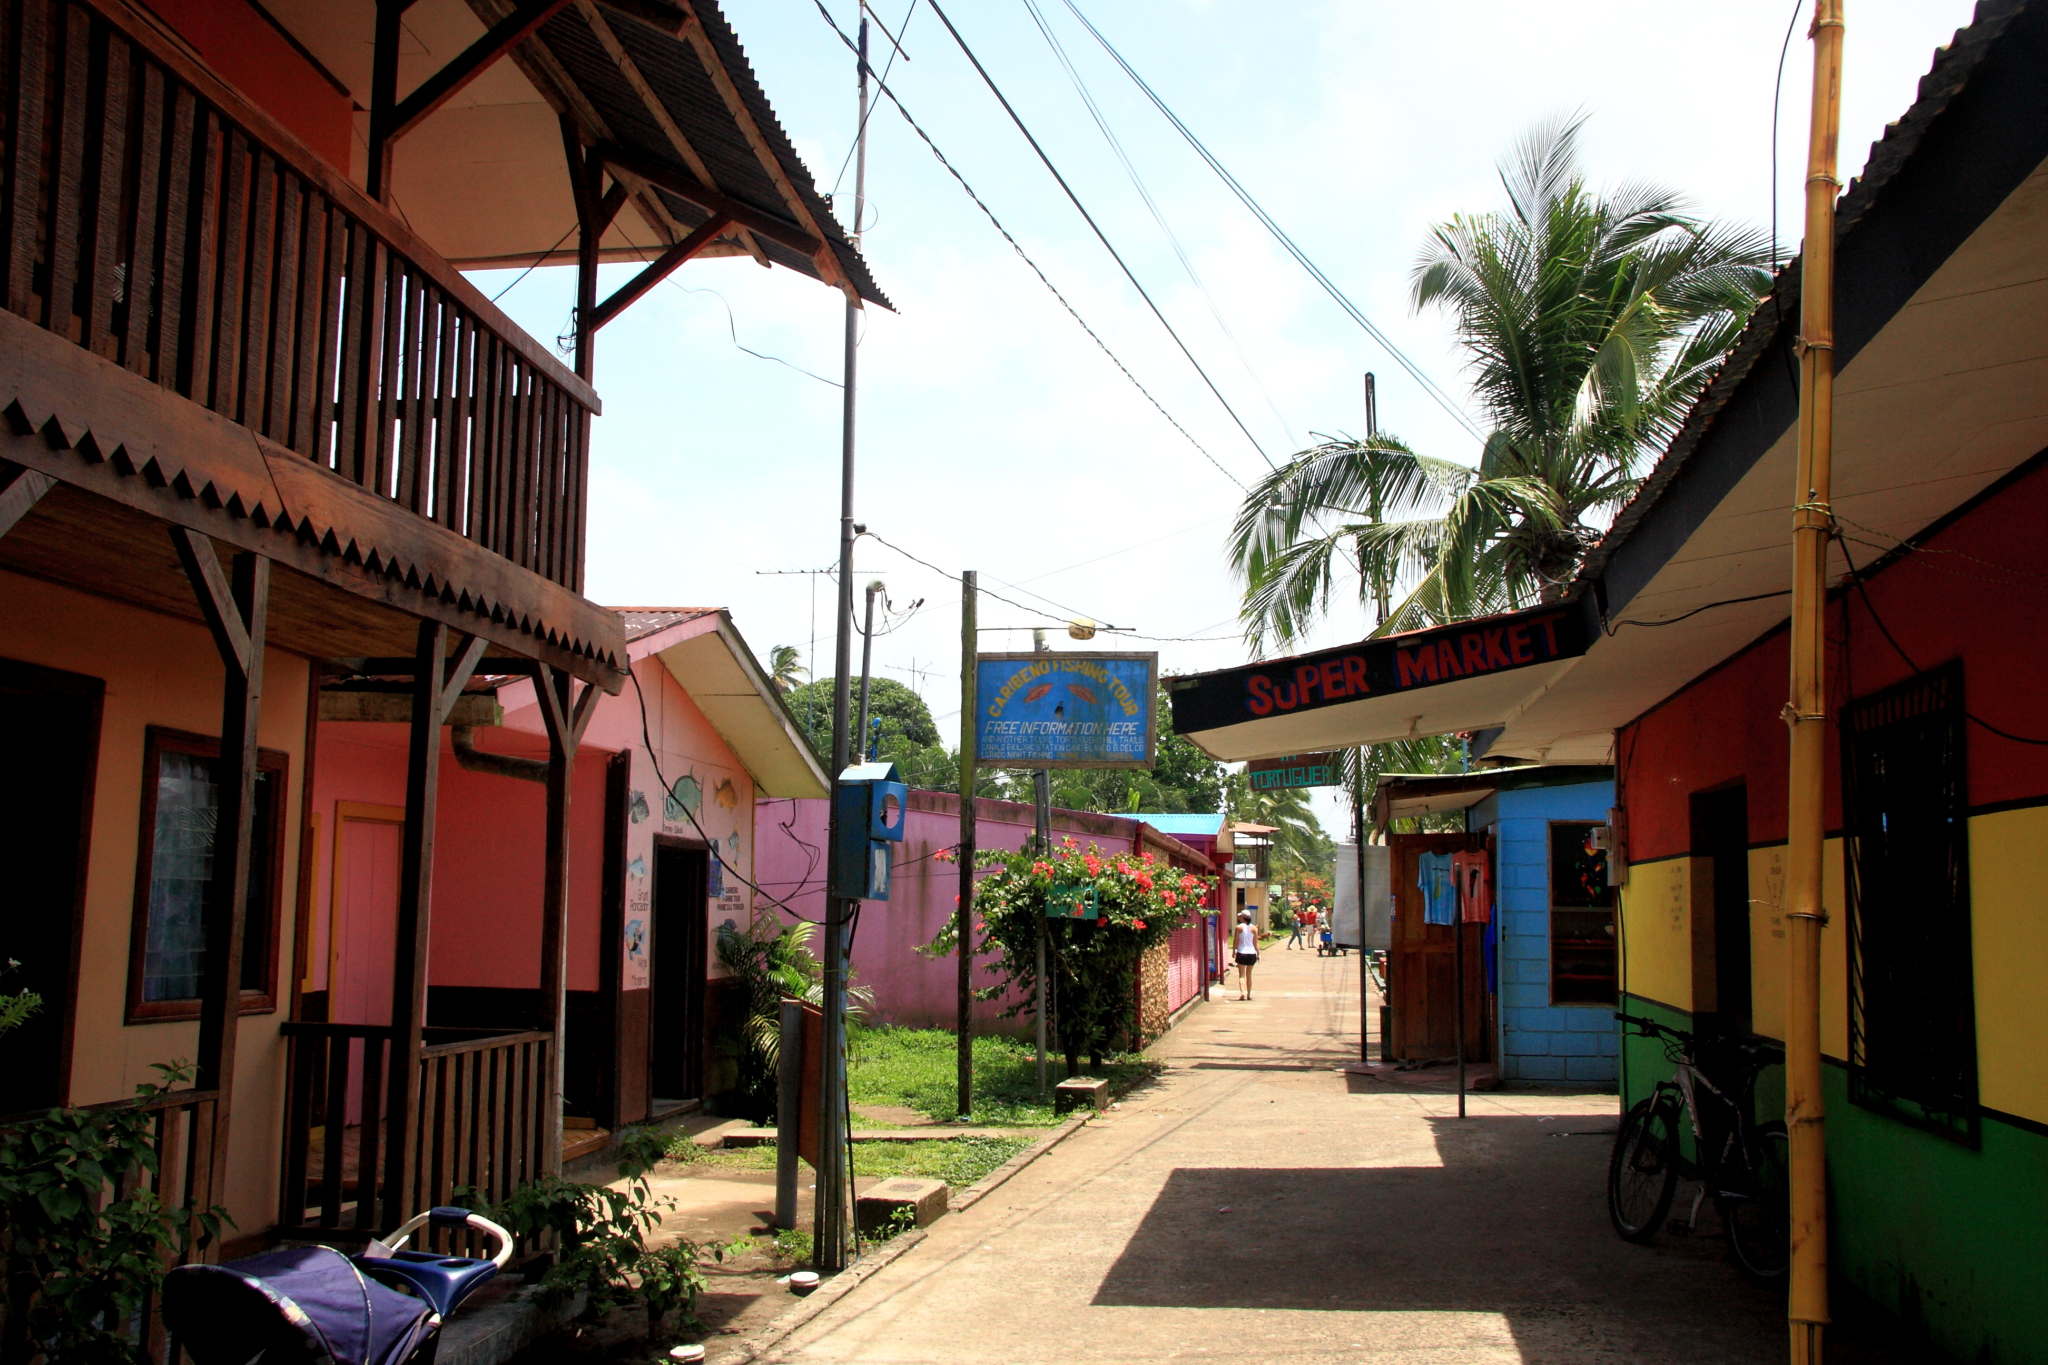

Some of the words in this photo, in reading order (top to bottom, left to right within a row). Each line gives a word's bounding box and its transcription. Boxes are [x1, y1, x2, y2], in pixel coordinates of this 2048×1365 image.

[1394, 611, 1567, 687] MARKET
[1052, 659, 1110, 683] FISHING
[1108, 676, 1139, 717] TOUR
[985, 721, 1020, 735] FREE
[1020, 721, 1103, 735] INFORMATION
[997, 735, 1028, 744] ANOTHER
[1030, 735, 1054, 744] TOURS
[1119, 736, 1144, 744] TRAILS
[1036, 743, 1065, 752] STATION
[1007, 751, 1027, 759] NIGHT
[1028, 751, 1054, 759] FISHING
